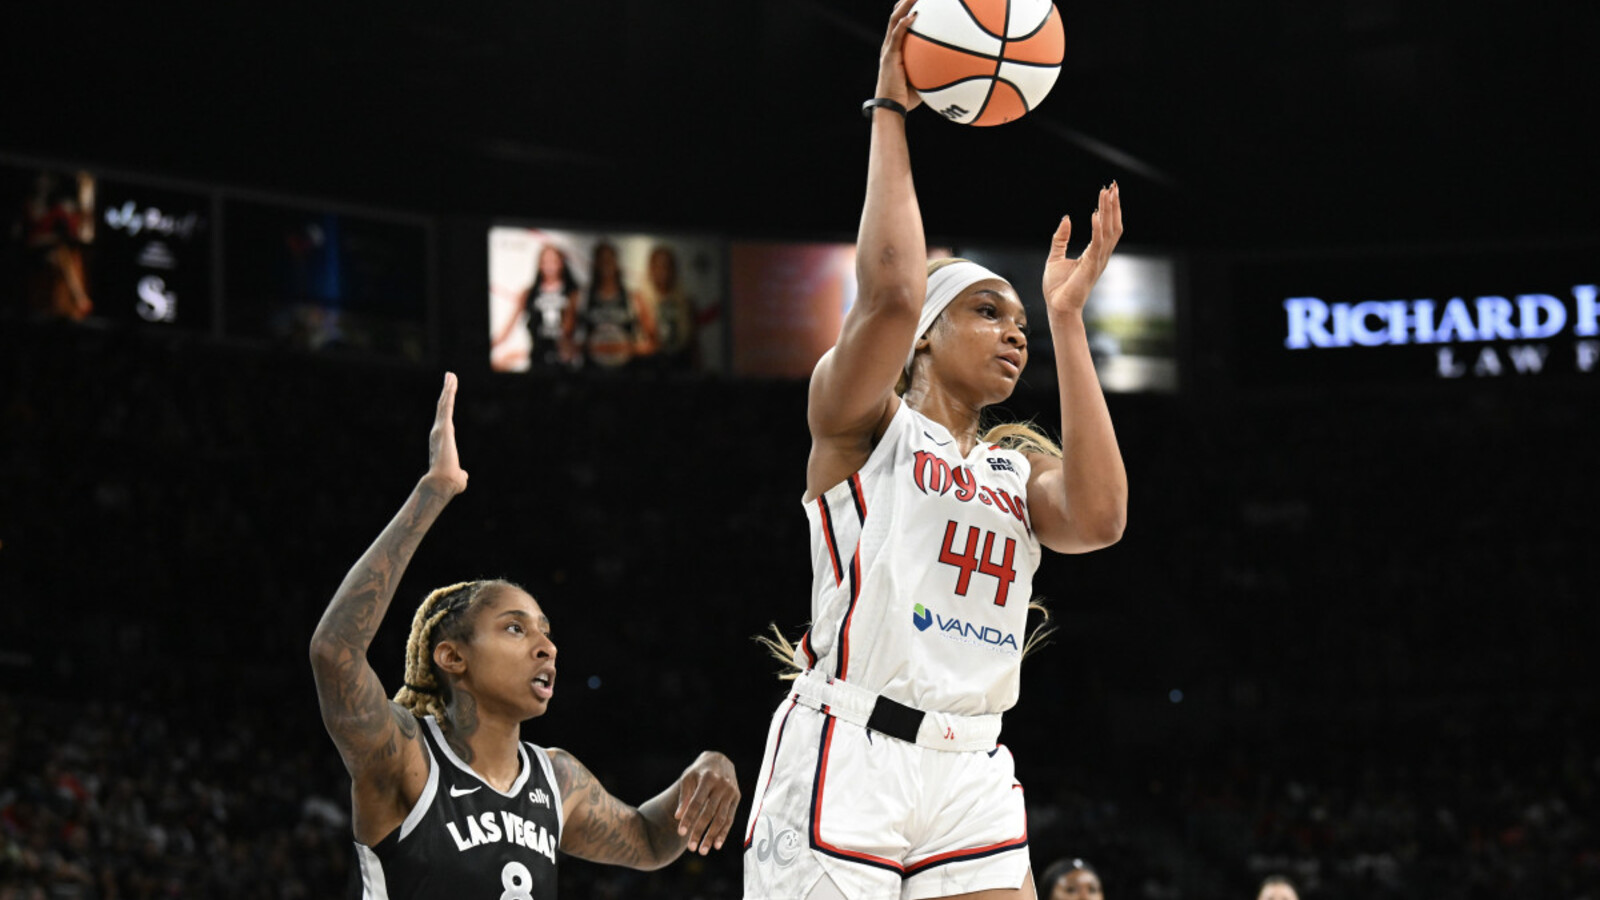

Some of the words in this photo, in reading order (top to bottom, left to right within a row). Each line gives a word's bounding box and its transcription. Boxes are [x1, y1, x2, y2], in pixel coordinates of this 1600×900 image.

[1284, 293, 1567, 349] RICHARD
[1437, 344, 1549, 377] LAW
[939, 520, 1016, 607] 44
[936, 613, 1018, 651] VANDA
[529, 788, 551, 810] ally
[446, 811, 503, 852] LAS
[499, 861, 534, 900] 8
